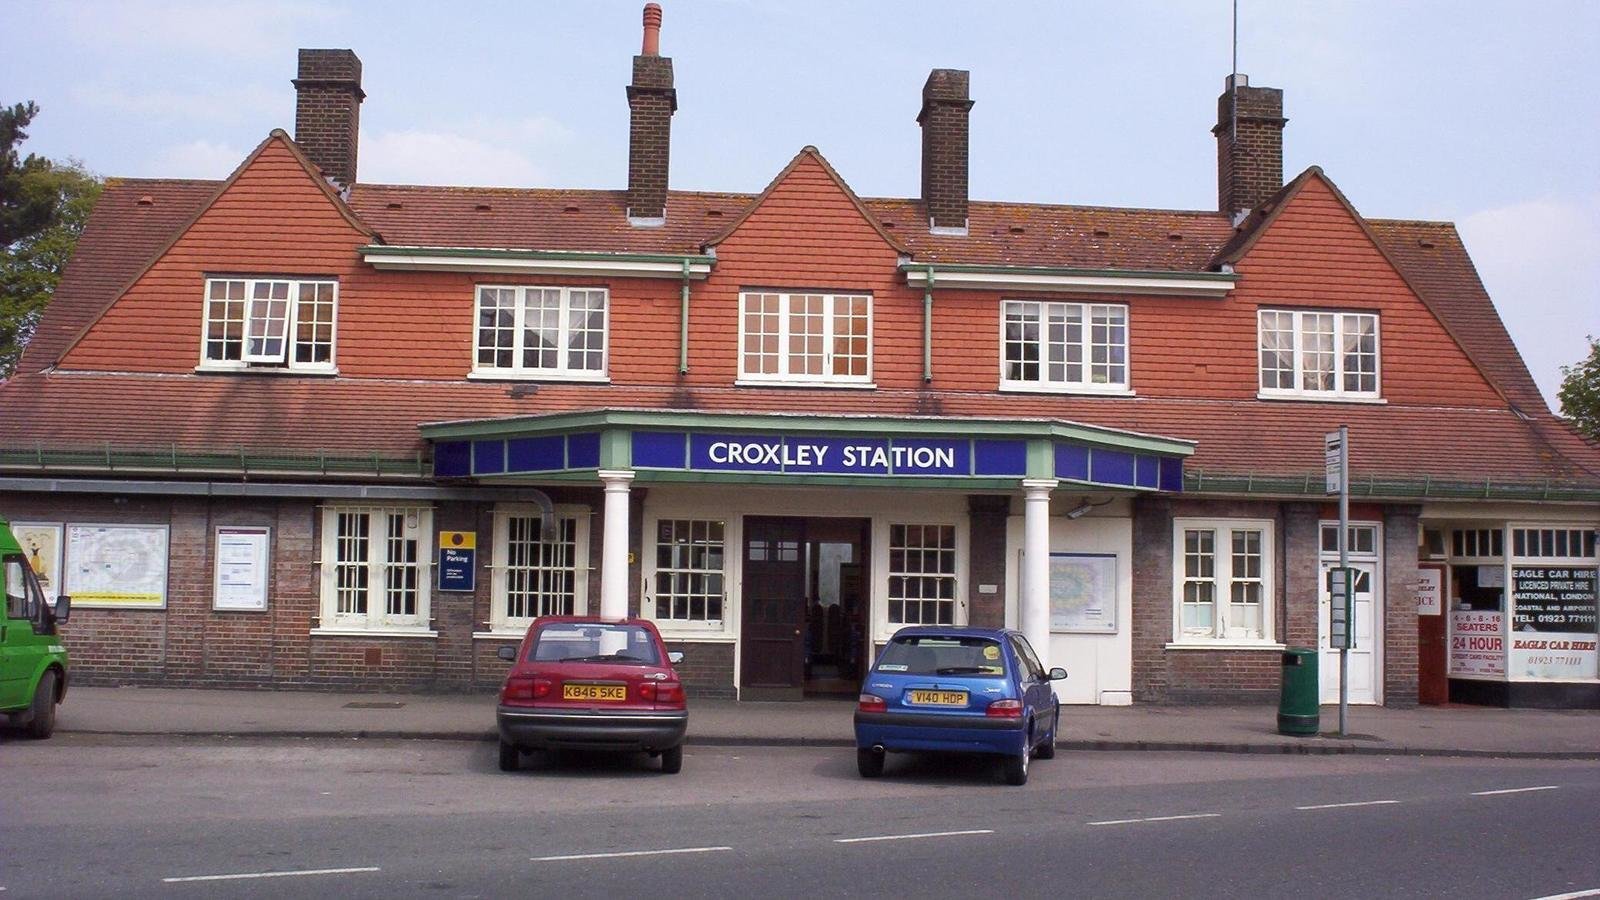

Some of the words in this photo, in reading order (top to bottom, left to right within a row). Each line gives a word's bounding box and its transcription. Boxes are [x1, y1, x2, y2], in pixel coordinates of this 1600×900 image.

[708, 442, 828, 466] CROXLEY
[842, 446, 954, 468] STATION
[1512, 570, 1544, 578] EAGLE
[1520, 581, 1548, 590] LICENCED
[1550, 582, 1574, 590] PRIVATE
[1575, 582, 1589, 590] HIRE
[1456, 623, 1498, 631] SEATERS
[1453, 637, 1465, 649] 24
[1470, 638, 1502, 650] HOUR
[1514, 640, 1547, 650] EAGLE
[1549, 641, 1570, 650] CAR
[1571, 642, 1596, 650] HIRE
[1556, 657, 1582, 665] 771111
[565, 686, 597, 698] K846
[600, 688, 624, 698] SKE
[916, 693, 938, 703] V140
[942, 694, 964, 704] HDP
